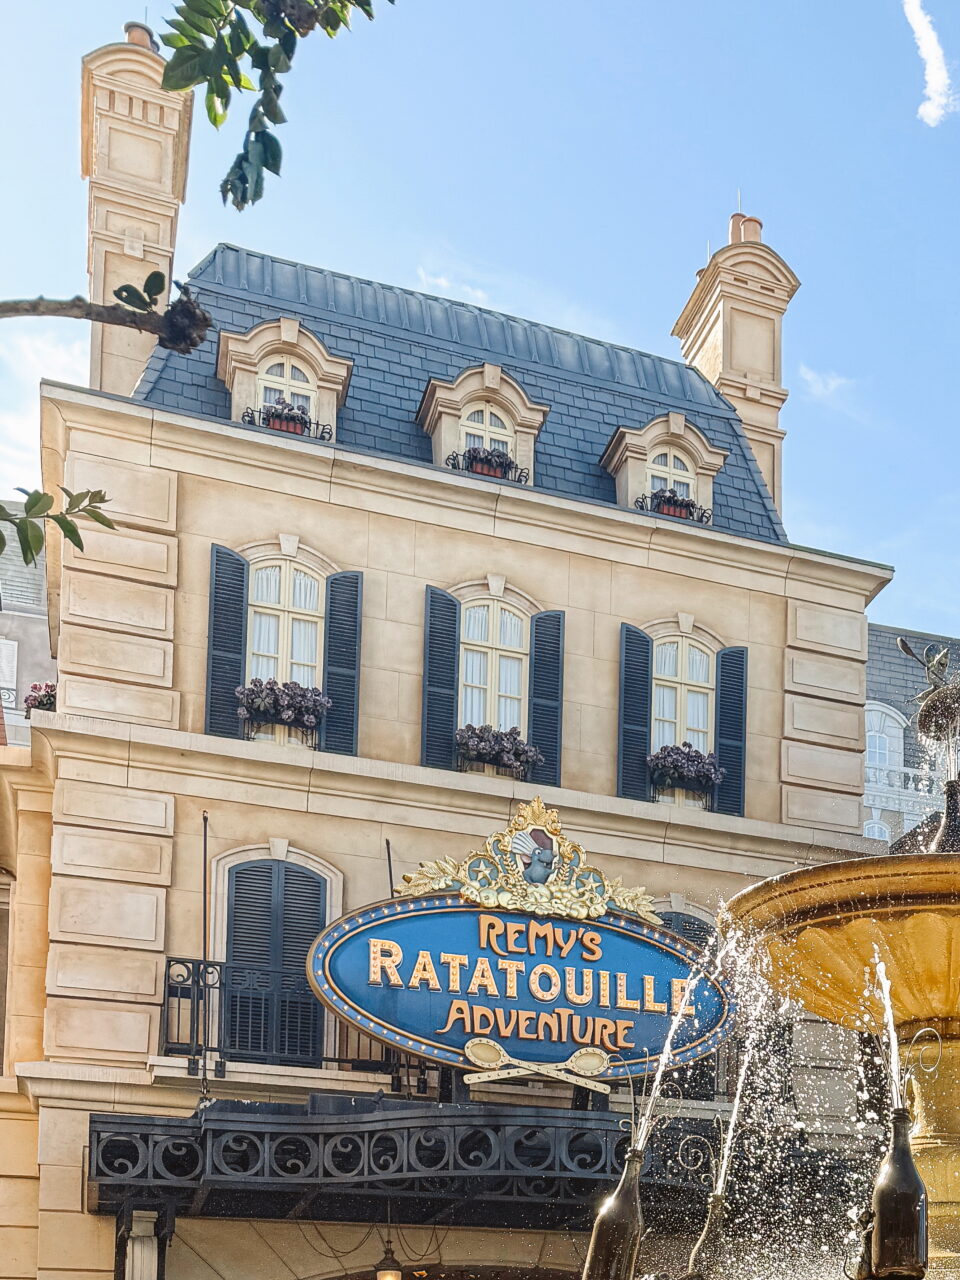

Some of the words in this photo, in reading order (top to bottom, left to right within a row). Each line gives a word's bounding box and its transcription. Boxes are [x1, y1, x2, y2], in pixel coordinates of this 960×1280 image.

[478, 914, 604, 962] REMY'S
[367, 938, 696, 1017] RATATOUILLE
[435, 999, 636, 1051] ADVENTURE
